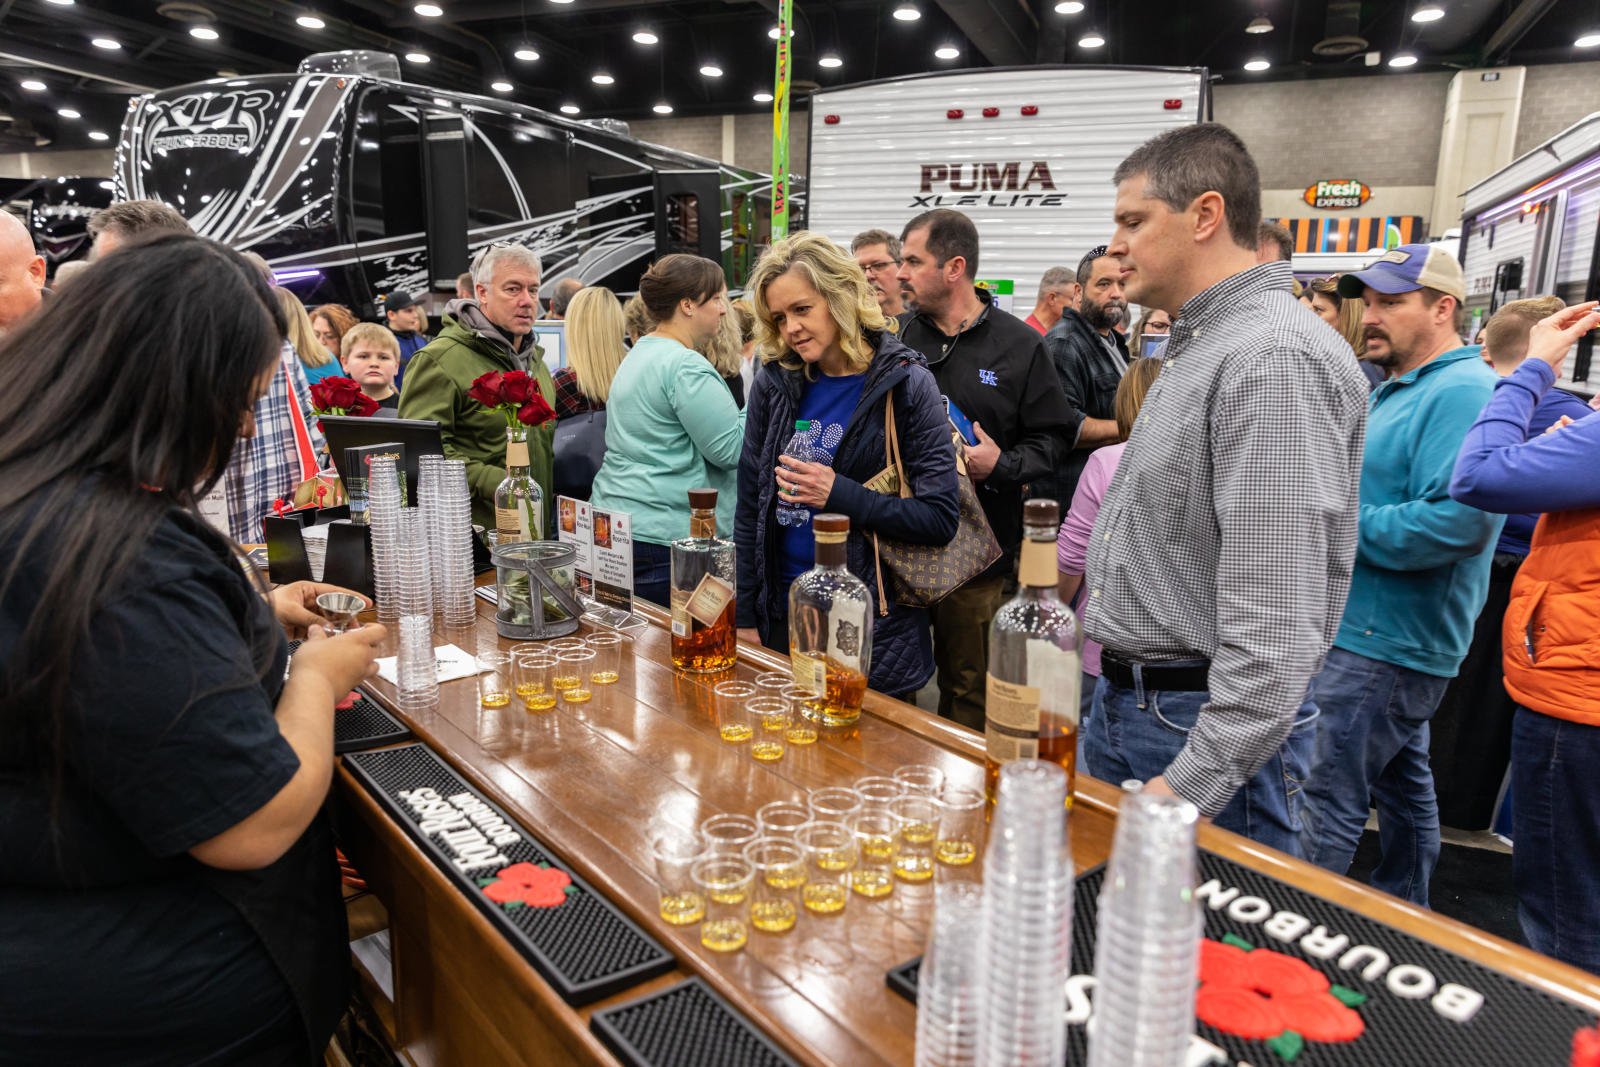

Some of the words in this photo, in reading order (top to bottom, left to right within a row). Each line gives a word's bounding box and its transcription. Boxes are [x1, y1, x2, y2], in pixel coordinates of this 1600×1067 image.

[146, 89, 274, 146] XLR
[152, 133, 249, 153] THUNDERBOLT
[919, 161, 1057, 193] PUMA
[1316, 180, 1362, 197] Fresh
[909, 194, 982, 207] XLE
[987, 193, 1068, 207] LITE
[1316, 197, 1360, 207] EXPRESS
[978, 368, 999, 387] UK
[447, 792, 521, 847] BOURBON
[1194, 878, 1485, 1024] BOURBON
